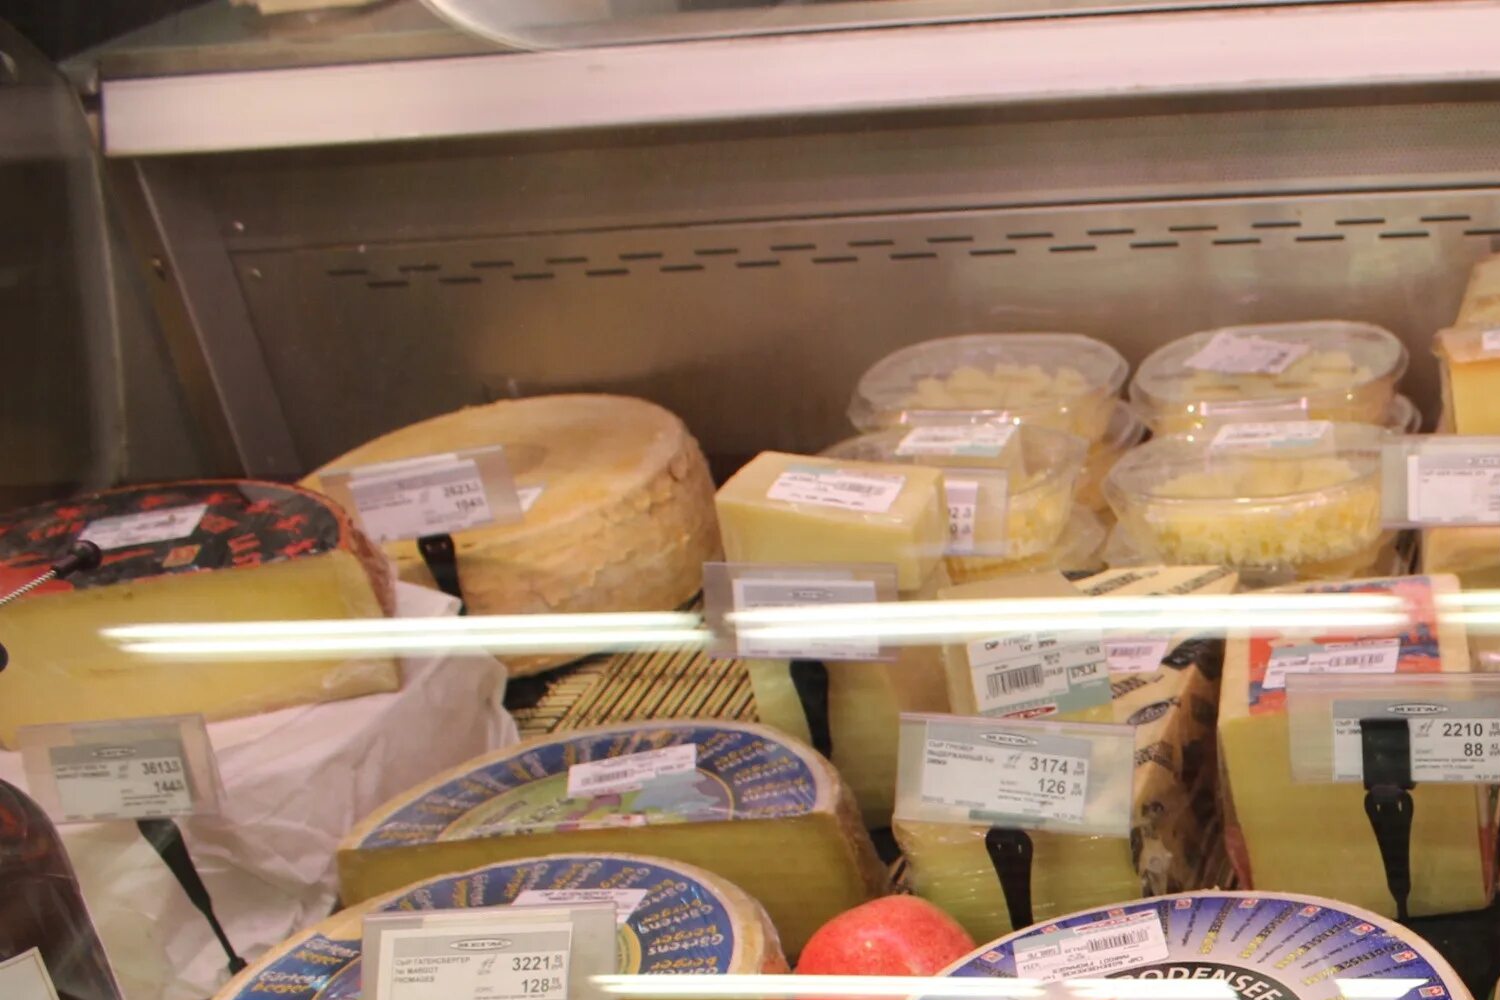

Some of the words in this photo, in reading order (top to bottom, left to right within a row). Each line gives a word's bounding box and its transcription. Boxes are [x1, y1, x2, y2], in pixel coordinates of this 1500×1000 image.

[1443, 723, 1483, 737] 2210
[1464, 743, 1483, 757] 88
[1029, 756, 1069, 774] 3174
[1038, 778, 1066, 795] 126
[512, 956, 550, 971] 3221
[521, 979, 550, 993] 128
